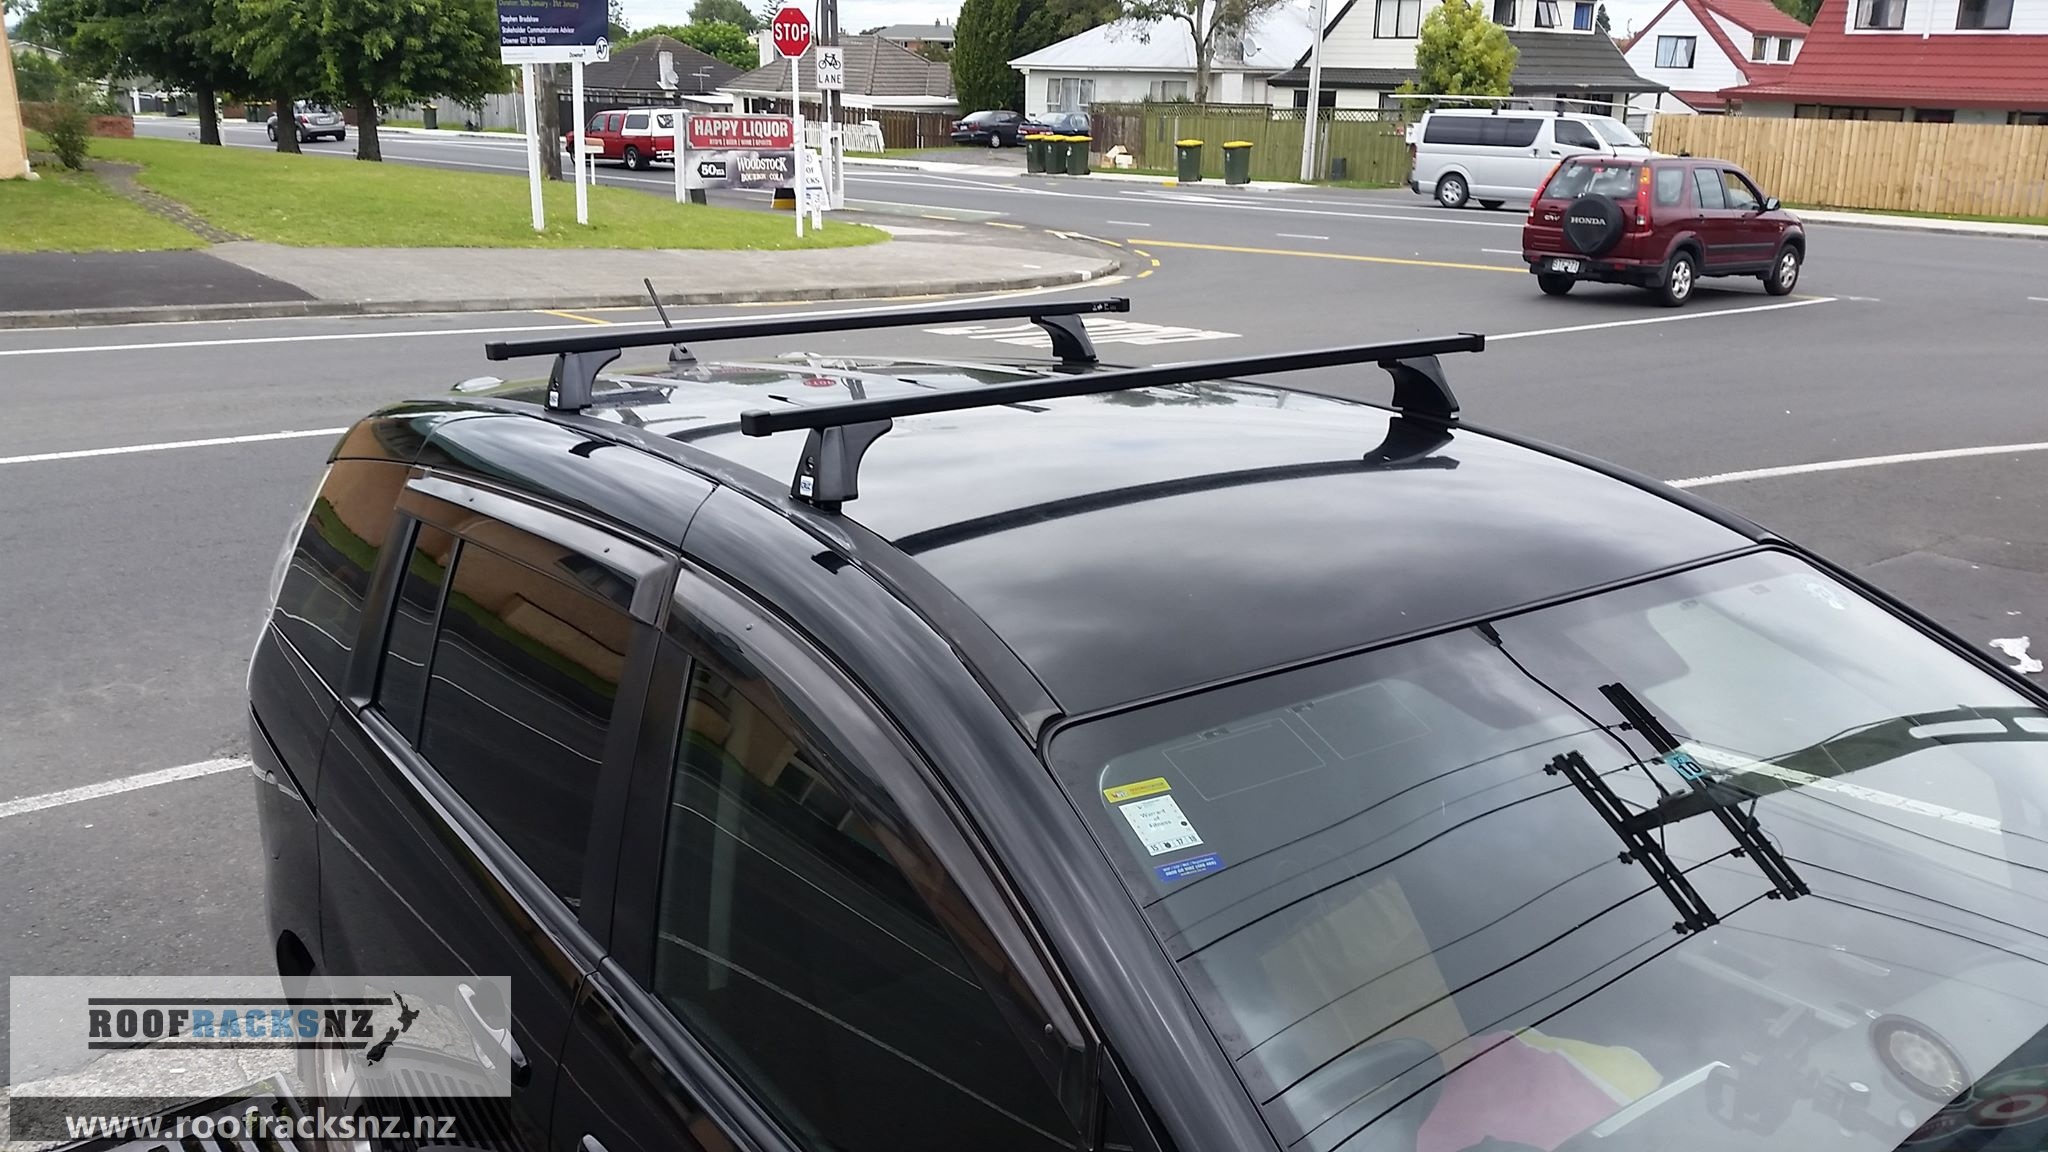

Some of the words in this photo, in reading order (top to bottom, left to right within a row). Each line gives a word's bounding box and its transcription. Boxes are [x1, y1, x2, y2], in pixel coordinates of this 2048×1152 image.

[500, 15, 518, 24] Stephen
[775, 22, 809, 41] STOP
[818, 74, 842, 84] LANE
[694, 119, 738, 136] HAPPY
[742, 120, 788, 138] LIQUOR
[736, 156, 788, 172] WOODSTOCK
[701, 164, 725, 176] 50m
[741, 173, 766, 182] BOURBON
[769, 173, 784, 181] COLA
[1570, 216, 1607, 225] HONDA
